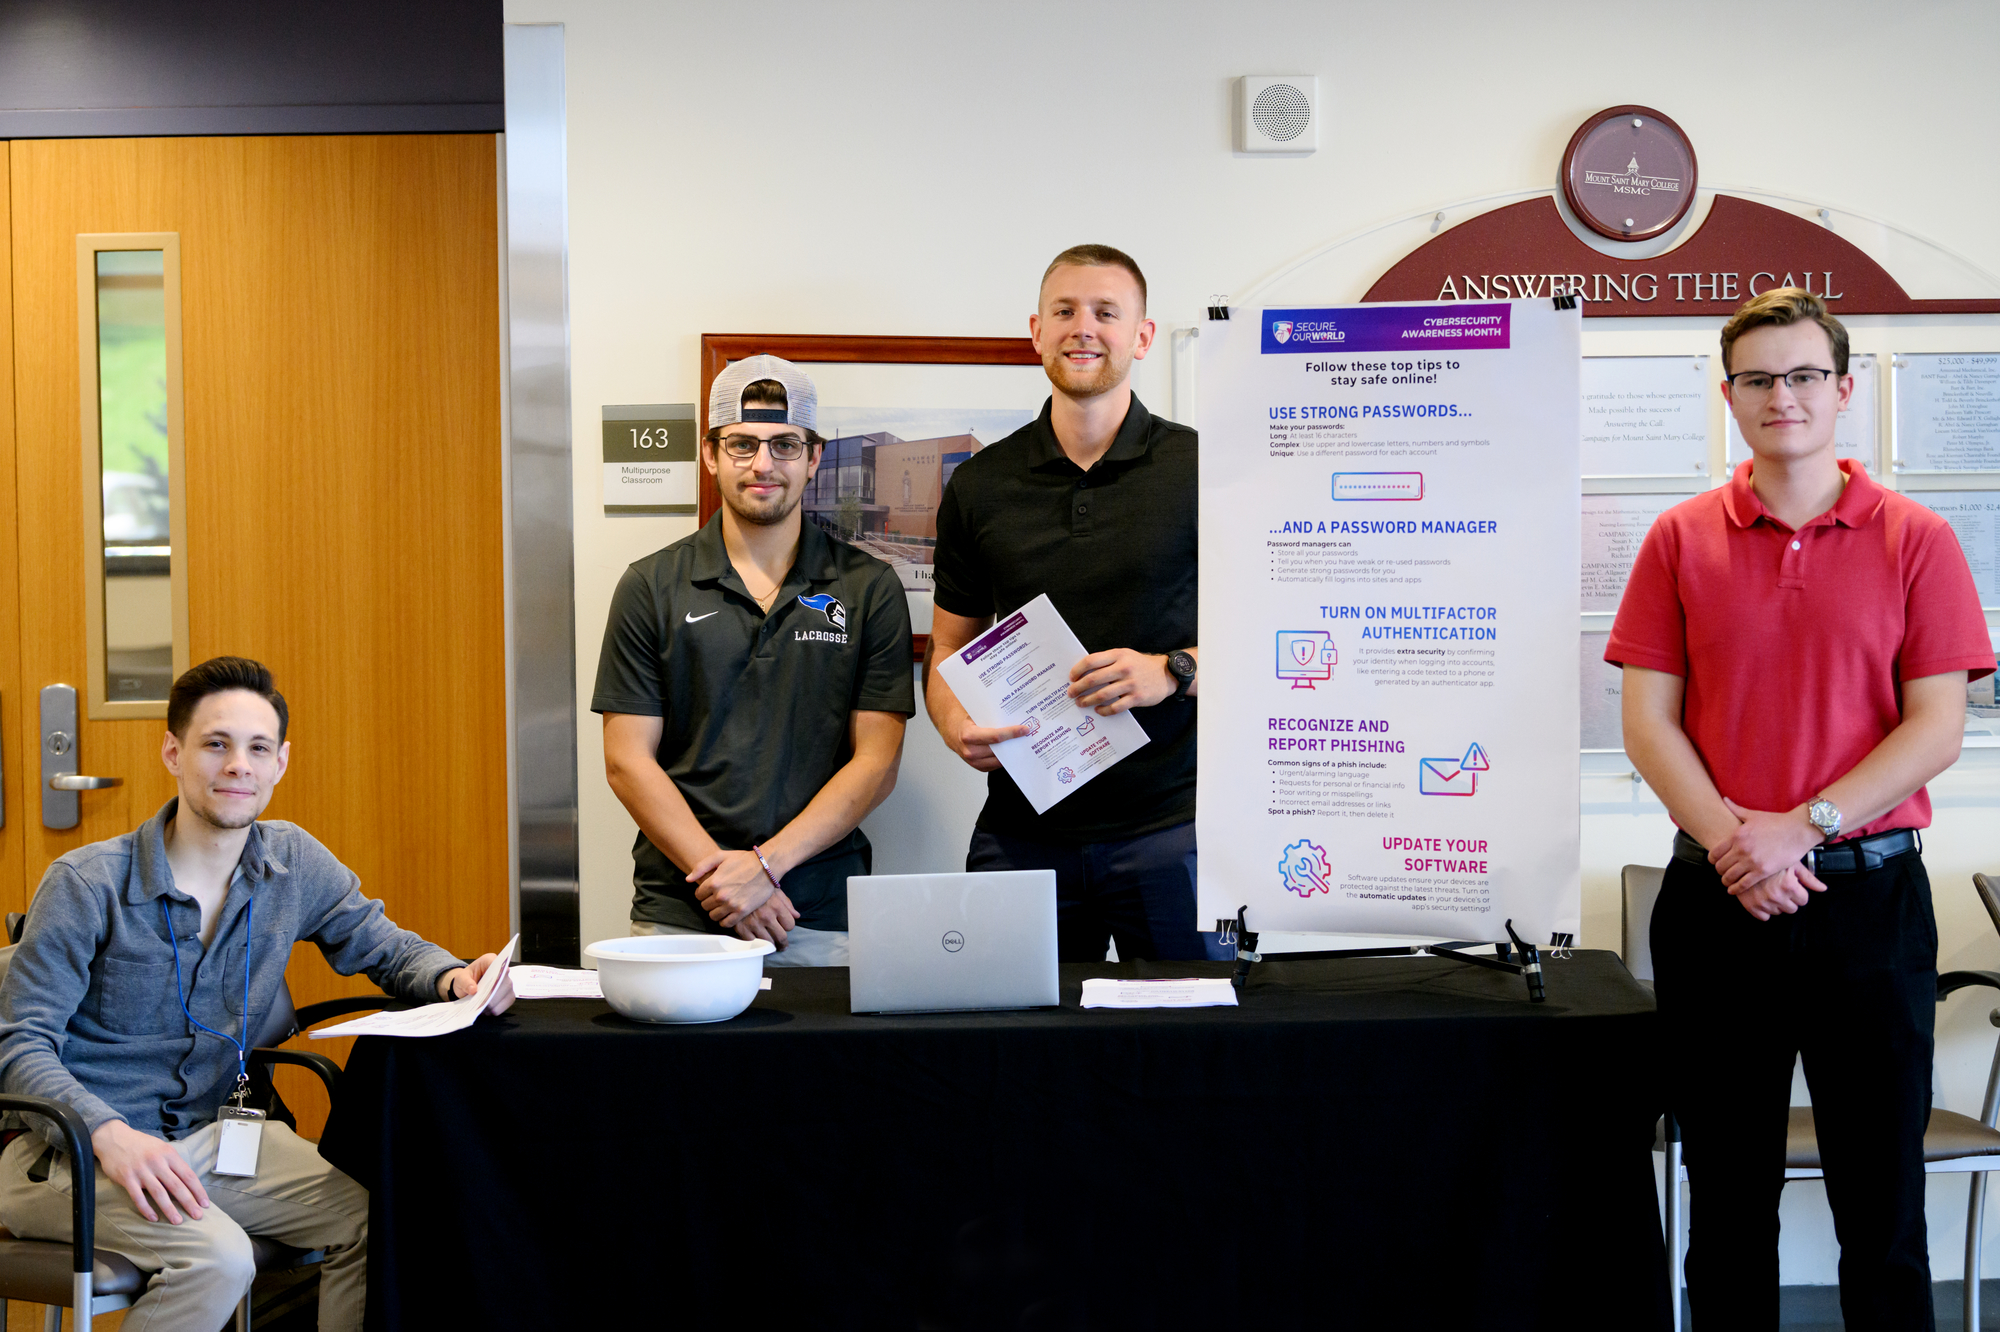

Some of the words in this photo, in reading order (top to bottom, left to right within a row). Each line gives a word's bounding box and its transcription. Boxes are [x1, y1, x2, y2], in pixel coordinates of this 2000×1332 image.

[1614, 185, 1651, 196] MSMC
[1437, 273, 1659, 302] ANSWERING
[1668, 272, 1741, 301] THE
[1749, 271, 1844, 299] CALL
[1422, 315, 1502, 326] CYBERSECURITY
[1295, 321, 1337, 332] SECURE
[1401, 328, 1463, 338] AWARENESS
[1464, 327, 1501, 337] MONTH
[1305, 361, 1347, 372] Follow
[1350, 360, 1387, 371] these
[1390, 361, 1413, 373] top
[1416, 358, 1442, 372] tips
[1445, 360, 1460, 370] to
[1330, 375, 1357, 388] stay
[1360, 373, 1387, 385] safe
[1391, 372, 1437, 384] online!
[1269, 406, 1297, 420] USE
[1300, 405, 1358, 419] STRONG
[1588, 406, 1607, 414] Made
[1673, 405, 1682, 413] of
[1289, 424, 1305, 432] your
[1306, 422, 1345, 431] passwords:
[630, 428, 668, 449] 163
[1460, 439, 1490, 447] symbols
[1378, 448, 1388, 456] for
[621, 466, 671, 476] Multipurpose
[621, 476, 663, 484] Classroom
[1316, 520, 1326, 534] A
[1330, 520, 1417, 534] PASSWORD
[1421, 520, 1497, 534] MANAGER
[1319, 605, 1360, 619] TURN
[1364, 606, 1386, 619] ON
[1391, 606, 1496, 620] MULTIFACTOR
[794, 631, 848, 644] LACROSSE
[1361, 626, 1496, 640] AUTHENTICATION
[1365, 647, 1396, 656] provides
[1416, 647, 1446, 656] security
[1447, 648, 1456, 656] by
[1456, 648, 1495, 657] confirming
[1268, 717, 1354, 732] RECOGNIZE
[1357, 719, 1389, 733] AND
[1268, 737, 1327, 751] REPORT
[1330, 738, 1405, 753] PHISHING
[1267, 758, 1300, 766] Common
[1301, 759, 1321, 768] signs
[1337, 760, 1357, 769] phish
[1358, 761, 1386, 769] include:
[1278, 769, 1336, 779] Urgent/alarming
[1337, 770, 1370, 780] language
[1278, 778, 1311, 787] Requests
[1311, 779, 1322, 787] for
[1322, 780, 1352, 788] personal
[1361, 780, 1391, 789] financial
[1391, 781, 1406, 789] info
[1278, 788, 1295, 796] Poor
[1296, 789, 1321, 798] writing
[1330, 790, 1373, 799] misspellings
[1267, 807, 1284, 816] Spot
[1291, 808, 1316, 816] phish?
[1366, 810, 1388, 818] delete
[1382, 836, 1441, 852] UPDATE
[1445, 838, 1488, 853] YOUR
[1404, 857, 1488, 874] SOFTWARE
[1359, 892, 1396, 900] automatic
[1397, 893, 1427, 902] updates
[1435, 896, 1452, 904] your
